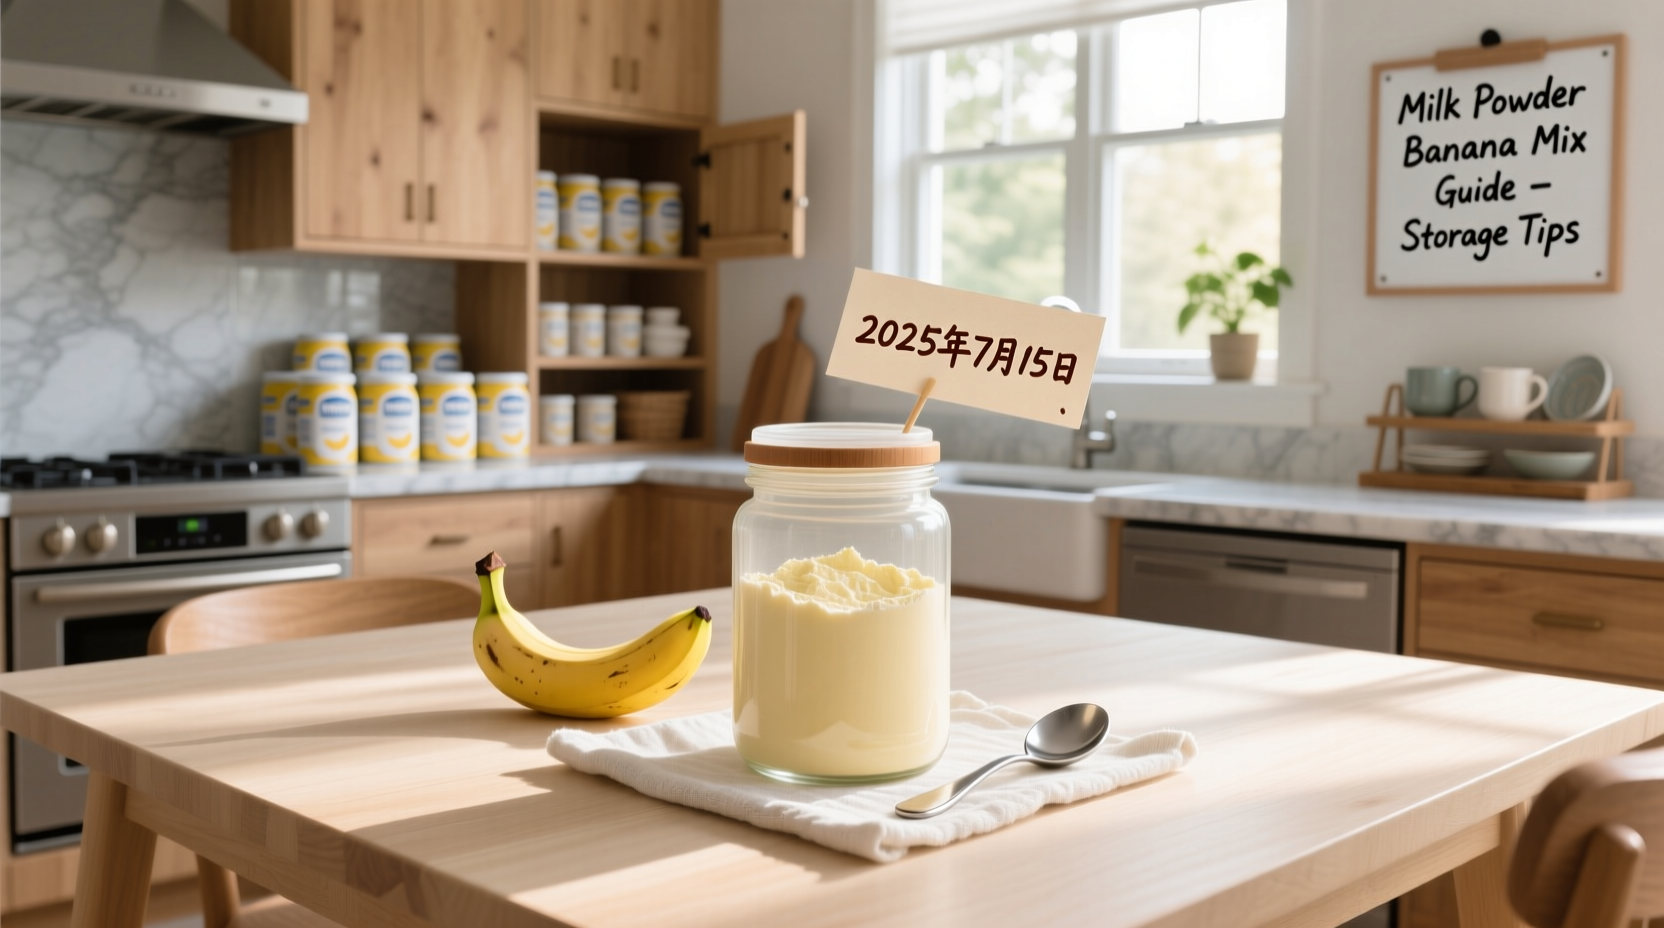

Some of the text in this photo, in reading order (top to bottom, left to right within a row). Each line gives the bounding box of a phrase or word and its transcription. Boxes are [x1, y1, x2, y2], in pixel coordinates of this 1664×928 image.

[1397, 74, 1587, 126] Milk Powder
[1403, 123, 1588, 168] Banana Mix
[1434, 170, 1517, 209] Guide
[1400, 212, 1580, 262] Storage Tips
[854, 314, 1078, 386] 2025年7月15日
